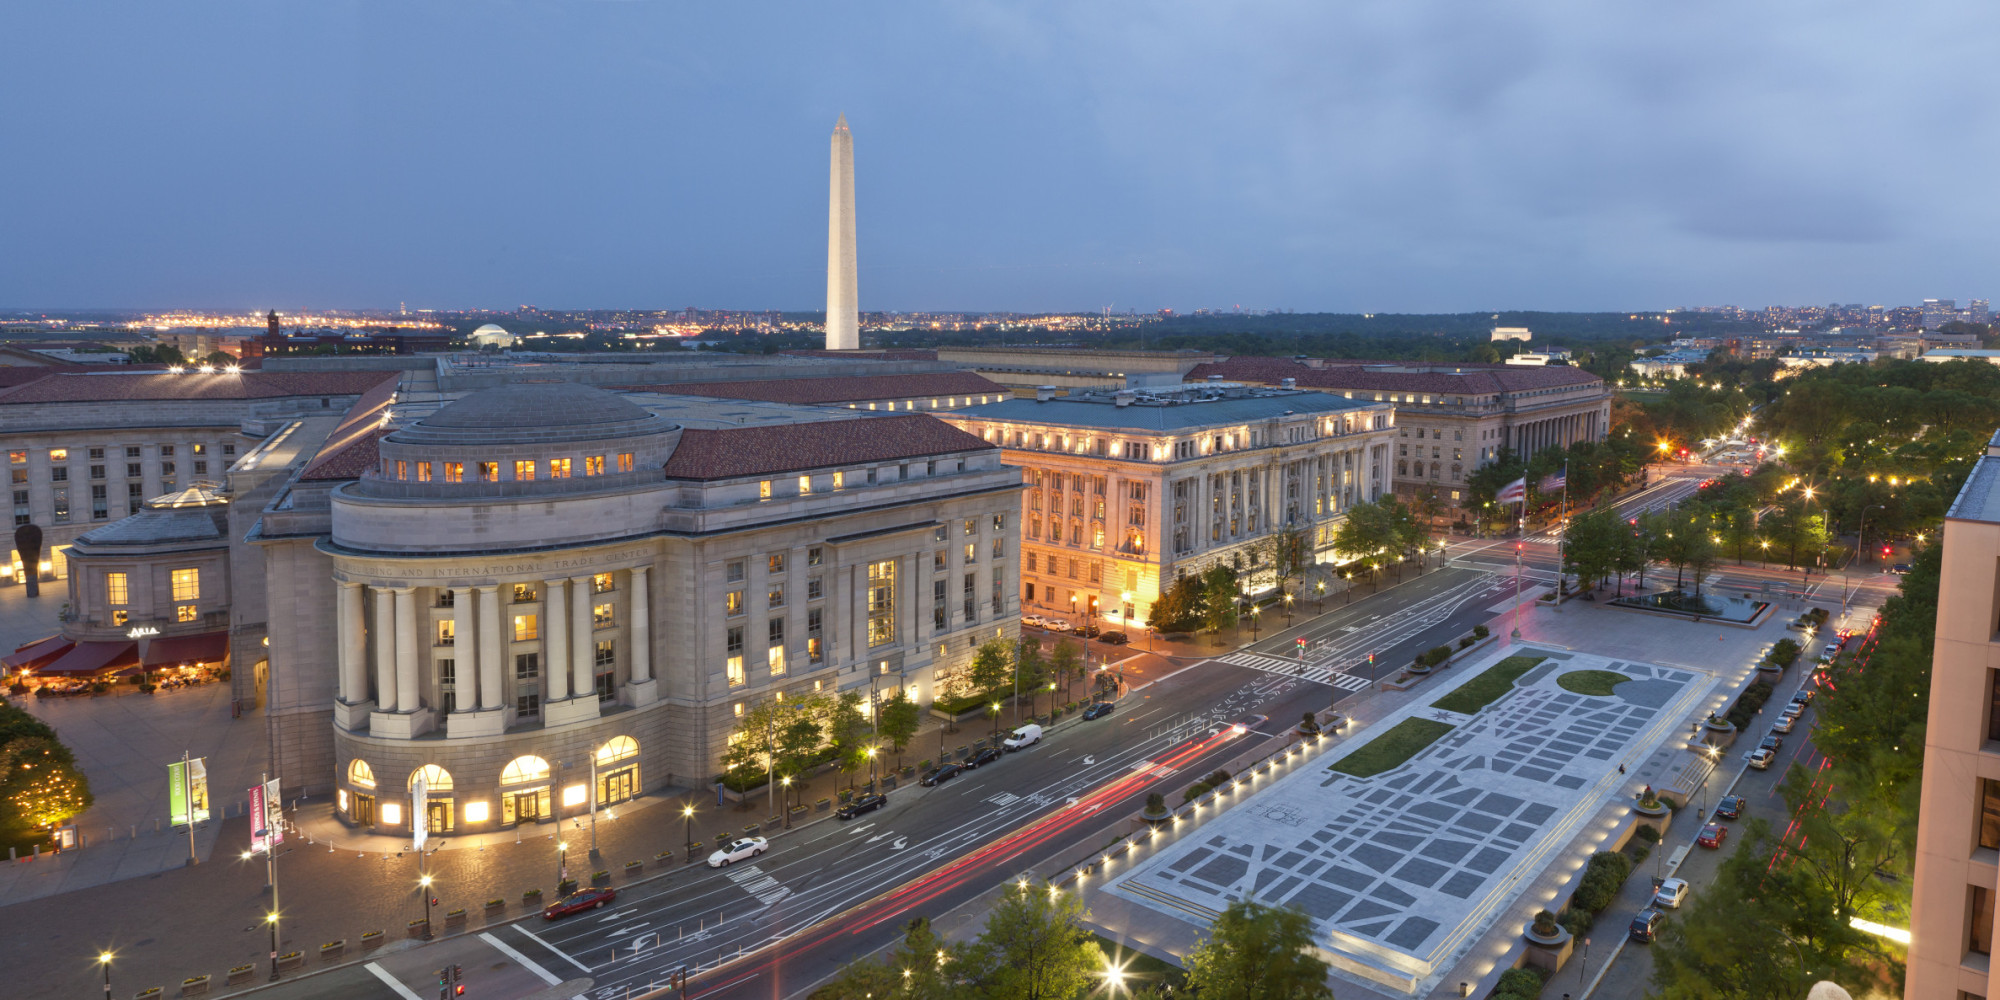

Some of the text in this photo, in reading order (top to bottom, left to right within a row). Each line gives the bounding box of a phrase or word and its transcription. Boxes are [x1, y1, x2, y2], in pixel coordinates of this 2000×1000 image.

[401, 568, 423, 577] AND
[433, 563, 543, 577] INTERNATIONAL
[554, 557, 595, 569] TRADE
[606, 549, 649, 562] CENTER
[126, 626, 161, 638] ARIA
